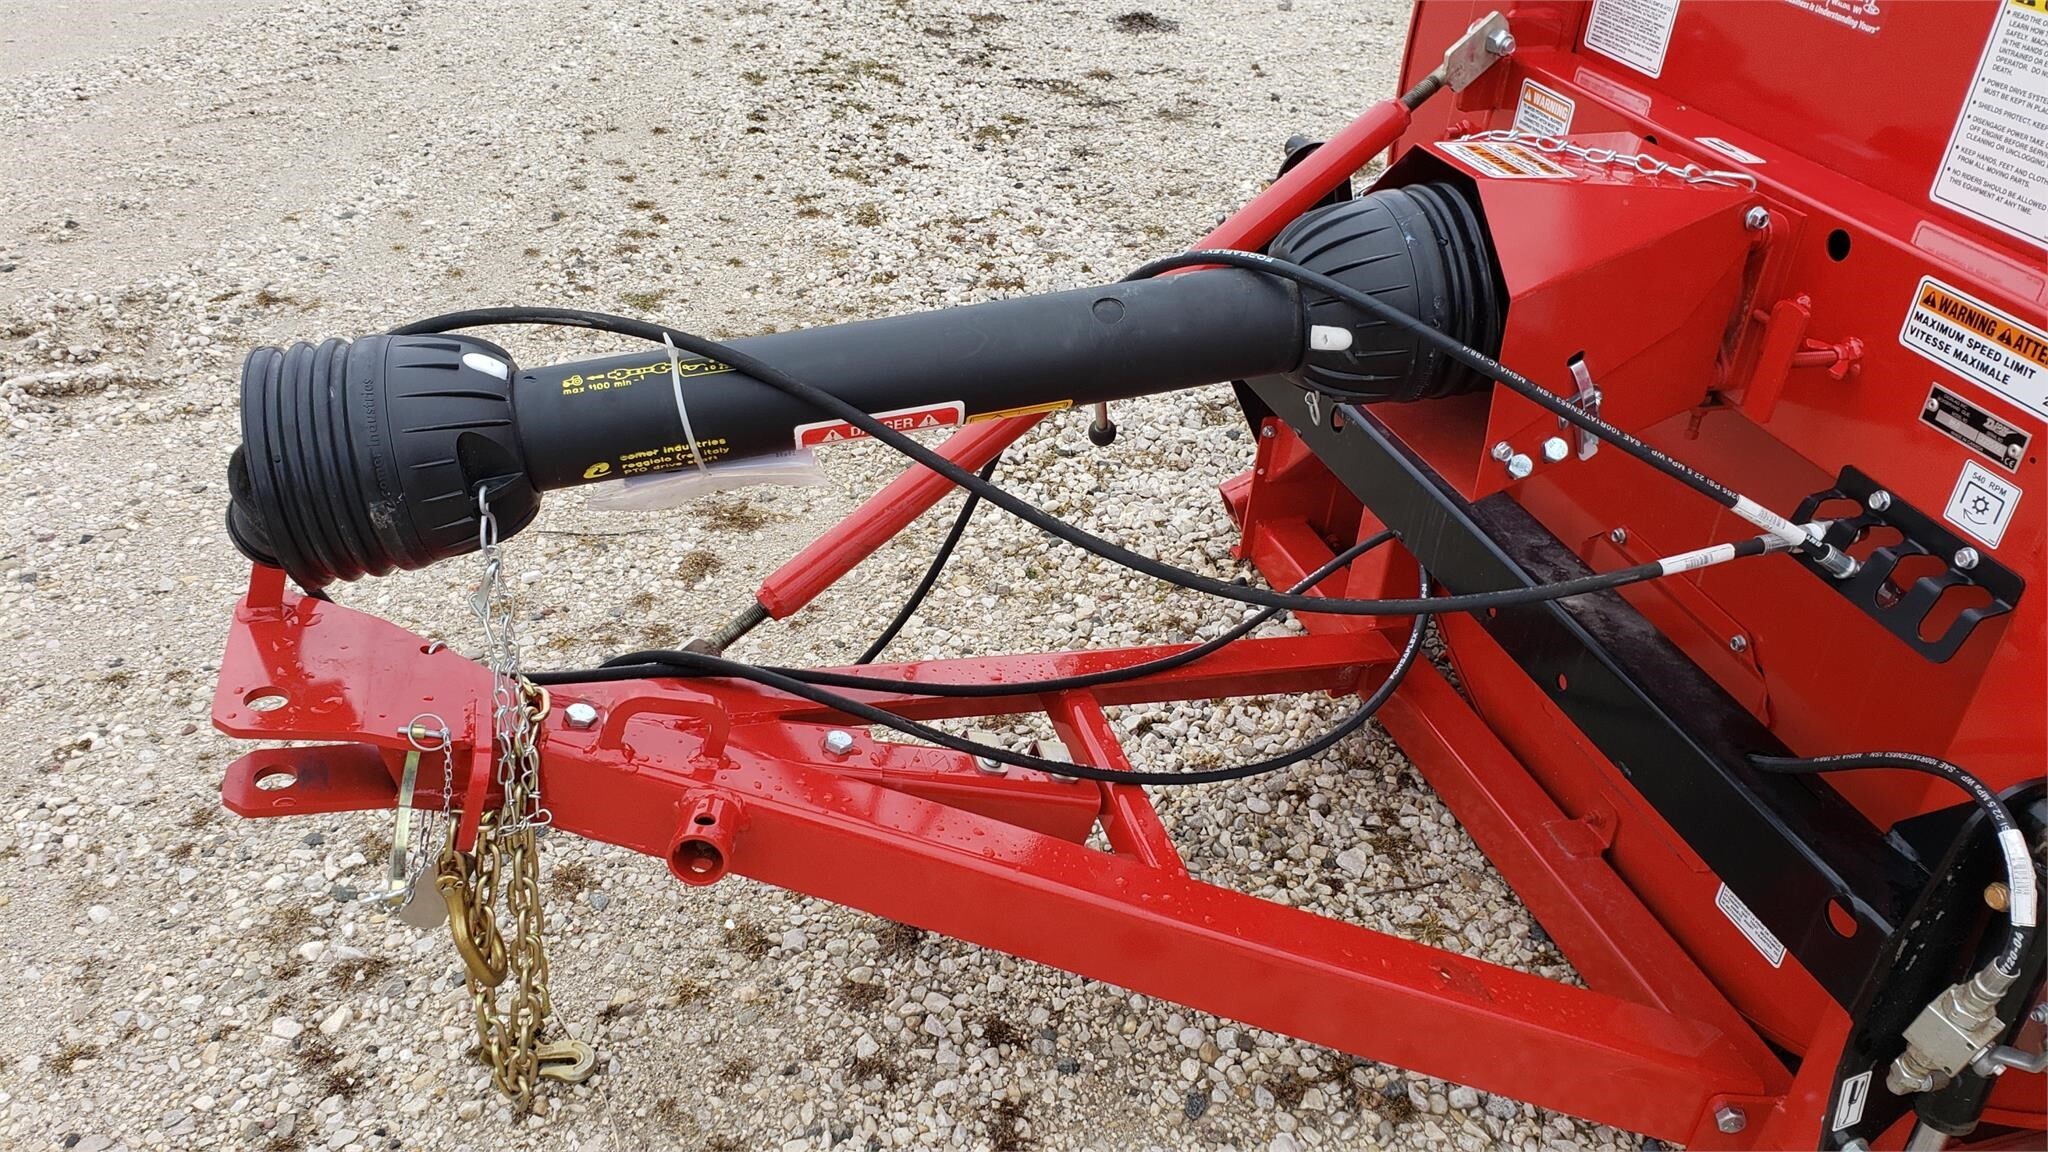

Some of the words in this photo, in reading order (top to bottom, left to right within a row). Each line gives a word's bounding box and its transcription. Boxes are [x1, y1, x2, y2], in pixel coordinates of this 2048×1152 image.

[2009, 20, 2029, 31] LEARN
[2012, 11, 2029, 21] READ
[2030, 16, 2042, 25] THE
[1999, 46, 2033, 62] UNTRAINED
[2034, 57, 2043, 65] OR
[2010, 39, 2021, 48] THE
[2022, 44, 2042, 55] HANDS
[2031, 66, 2040, 75] DO
[1987, 78, 2008, 91] POWER
[2009, 86, 2028, 97] DRIVE
[1533, 92, 1568, 121] WARNING
[1983, 87, 2000, 99] MUST
[2001, 92, 2009, 101] BE
[2010, 96, 2026, 106] KEPT
[2026, 101, 2033, 109] IN
[1978, 101, 2003, 115] SHIELDS
[1969, 124, 1981, 135] OFF
[1981, 128, 2003, 141] ENGINE
[2004, 137, 2028, 150] BEFORE
[1972, 115, 2006, 132] DISENGAGE
[2007, 128, 2028, 140] POWER
[2029, 135, 2045, 147] TAKE
[1966, 132, 1994, 147] CLEANING
[1995, 143, 2005, 152] OR
[2005, 147, 2045, 167] UNCLOGGING
[1957, 153, 1974, 165] FROM
[1974, 160, 1986, 170] ALL
[1986, 165, 2009, 179] MOVING
[1961, 147, 1976, 158] KEEP
[1998, 161, 2014, 171] FEET
[2014, 167, 2027, 177] AND
[1948, 176, 1962, 186] THIS
[1961, 181, 1995, 199] EQUIPMENT
[1995, 195, 2004, 203] AT
[2003, 198, 2016, 208] ANY
[1951, 167, 1961, 176] NO
[1961, 171, 1982, 185] RIDERS
[1982, 180, 2007, 195] SHOULD
[2007, 190, 2016, 198] BE
[2017, 195, 2047, 211] ALLOWED
[1938, 295, 1997, 337] WARNING
[2013, 334, 2048, 366] ATTE
[1910, 325, 1952, 354] VITESSE
[1953, 348, 2011, 385] MAXIMALE
[1914, 311, 1965, 344] MAXIMUM
[1966, 338, 2002, 362] SPEED
[2004, 357, 2036, 380] LIMIT
[1498, 364, 1526, 383] MSHA
[562, 387, 584, 396] max
[850, 417, 914, 437] DGER
[1622, 433, 1641, 446] SAE
[620, 448, 660, 461] comer
[663, 438, 727, 454] indutries
[1650, 448, 1666, 460] WP
[624, 466, 648, 475] PTO
[653, 462, 683, 470] drive
[1666, 456, 1685, 470] MPa
[1972, 471, 1986, 485] 540
[1988, 481, 2007, 497] RPM
[1938, 762, 1956, 773] SAE
[1960, 775, 1975, 786] WP
[1974, 784, 1992, 801] MPa
